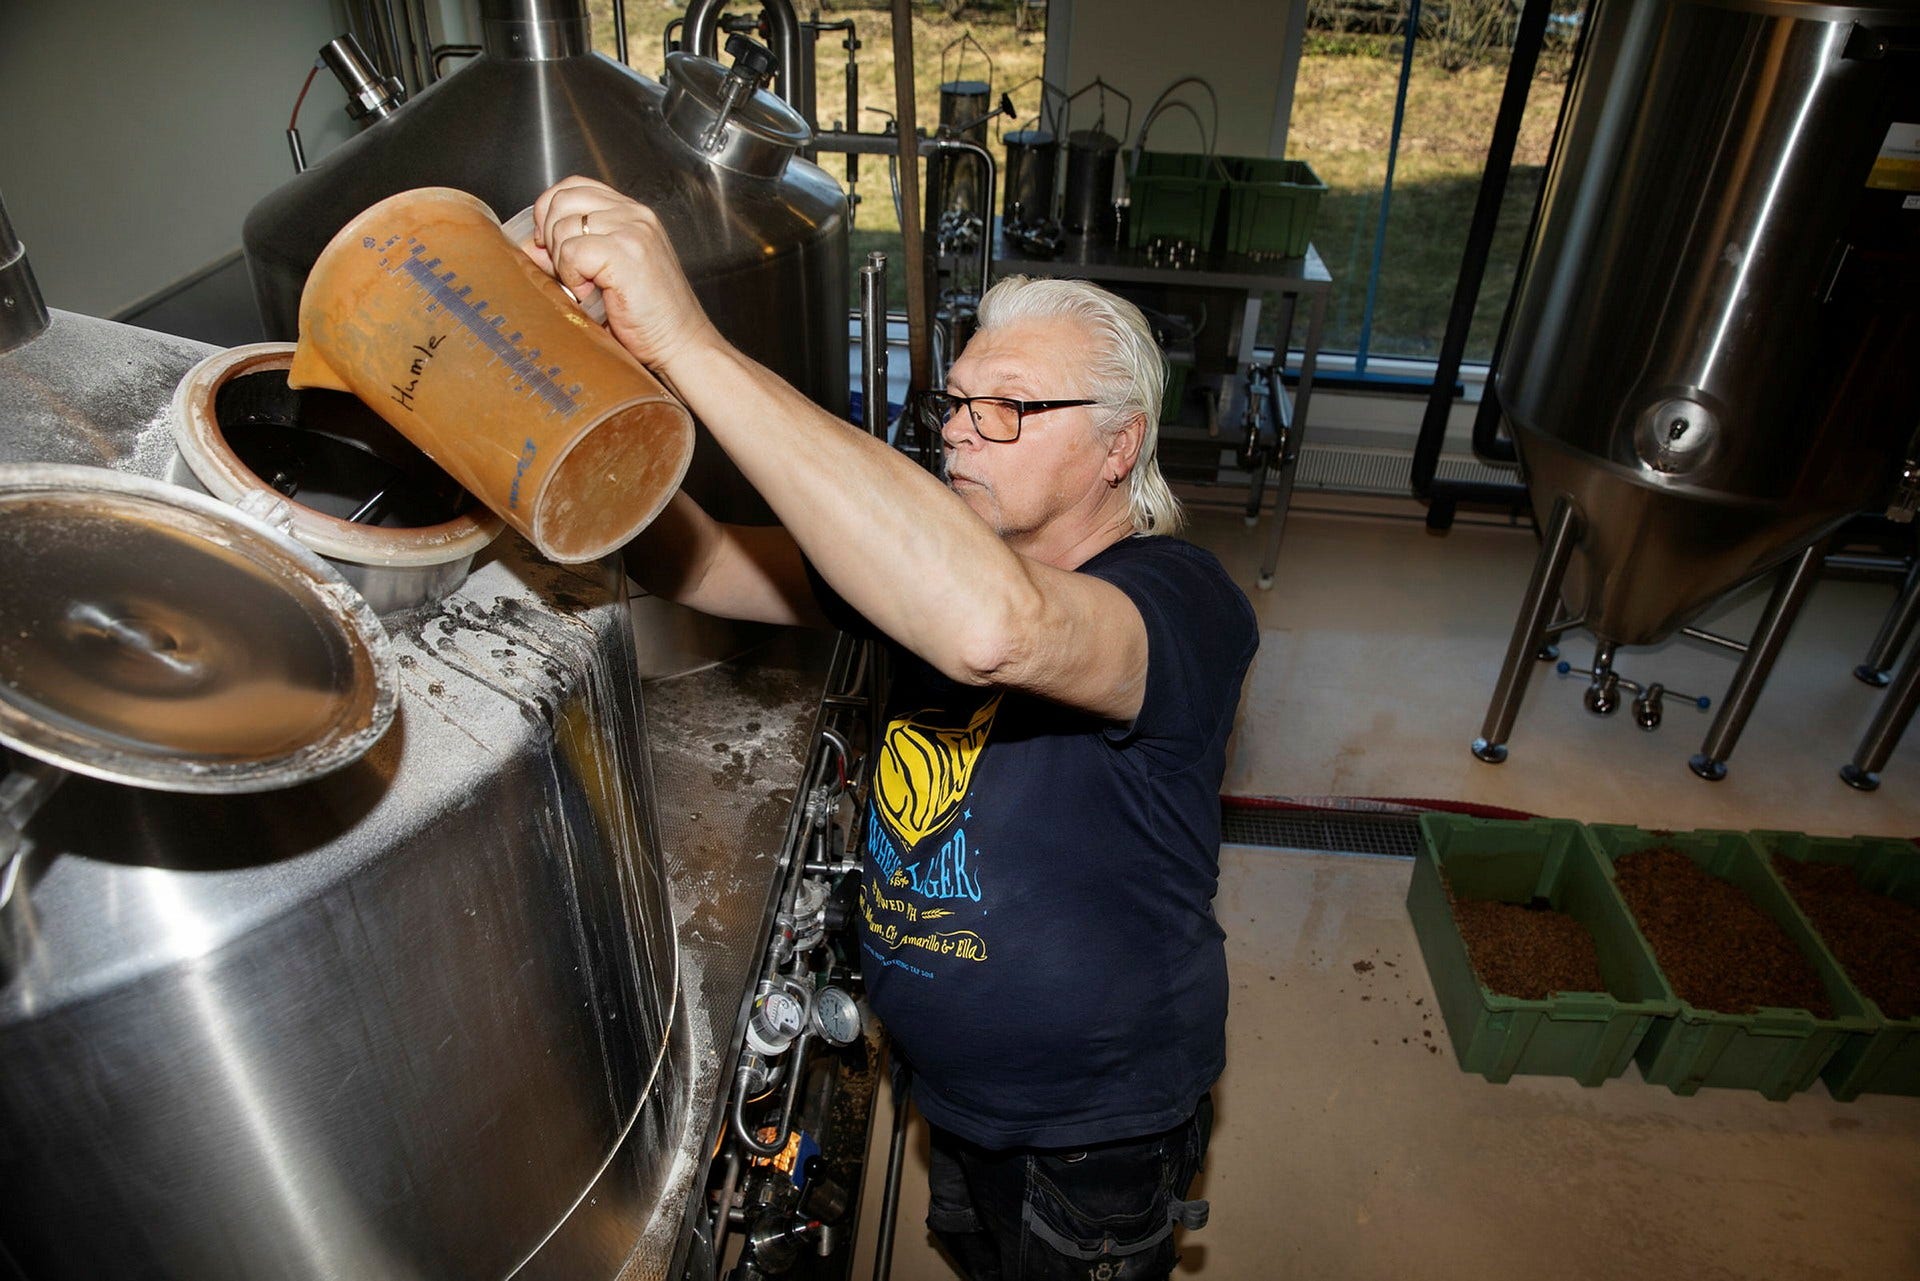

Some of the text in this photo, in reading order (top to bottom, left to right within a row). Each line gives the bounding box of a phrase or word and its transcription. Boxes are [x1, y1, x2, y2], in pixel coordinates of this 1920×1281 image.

[391, 335, 447, 412] Humle
[890, 934, 940, 953] Amarillo
[941, 939, 955, 955] &
[955, 937, 988, 961] Ella
